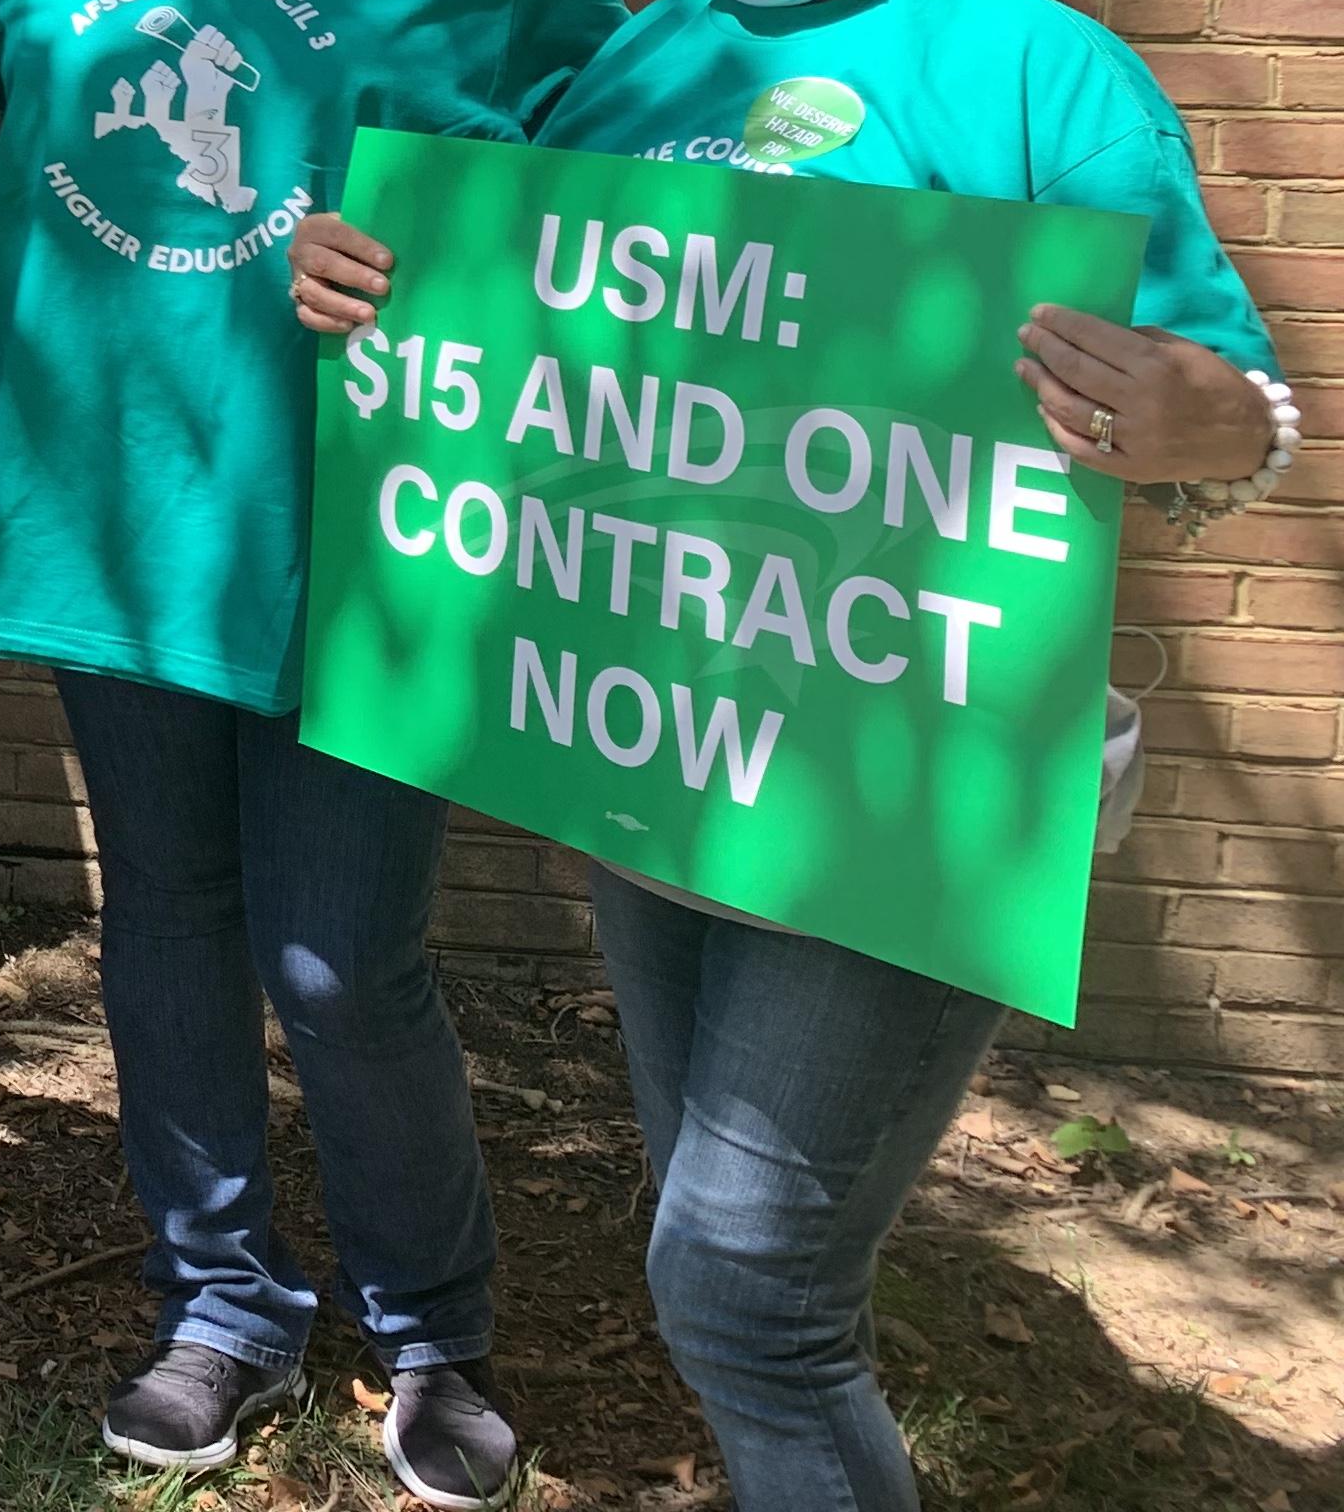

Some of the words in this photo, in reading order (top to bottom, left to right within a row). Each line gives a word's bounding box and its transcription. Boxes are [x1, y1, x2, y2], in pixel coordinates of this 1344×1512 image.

[309, 31, 336, 51] 3
[760, 141, 791, 157] PAY
[765, 116, 823, 148] HAZARD
[770, 87, 797, 111] WE
[793, 102, 857, 137] DESERVE
[189, 130, 231, 185] 3
[44, 162, 141, 262] HIGHER
[148, 185, 313, 273] EDUCATION
[533, 214, 807, 349] USM:
[344, 324, 483, 431] $15
[506, 356, 745, 485] AND
[784, 408, 1071, 562] ONE
[379, 464, 1002, 706] CONTRACT
[511, 638, 785, 807] NOW
